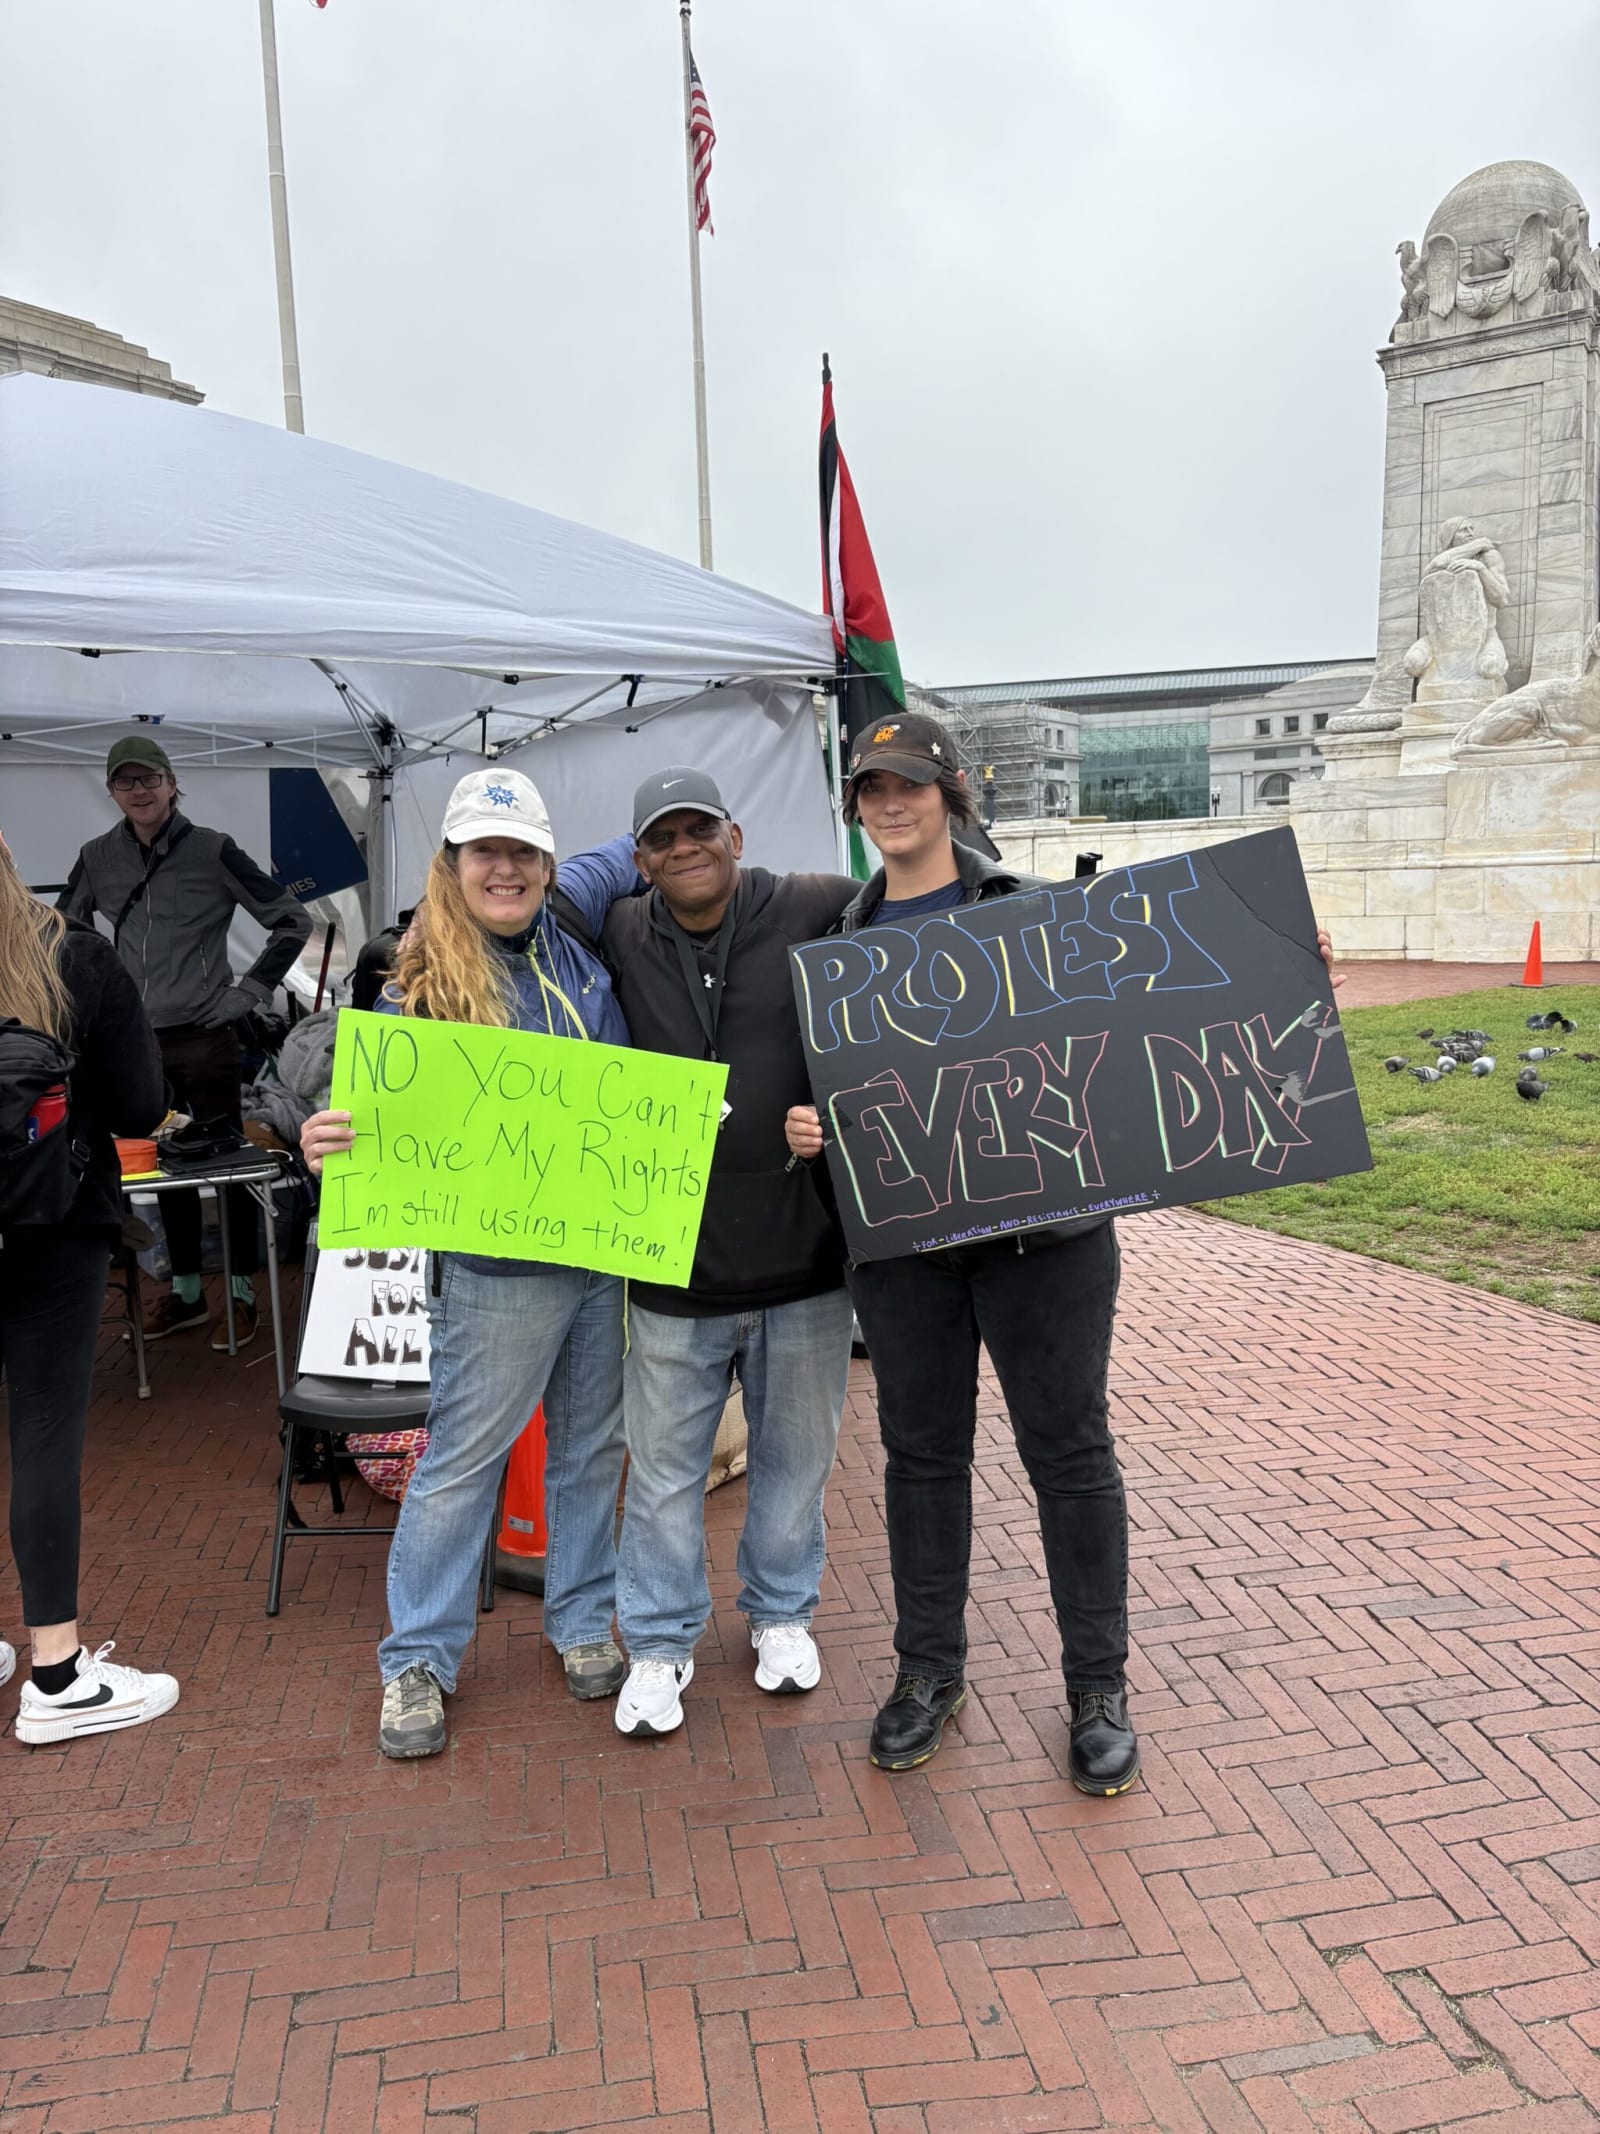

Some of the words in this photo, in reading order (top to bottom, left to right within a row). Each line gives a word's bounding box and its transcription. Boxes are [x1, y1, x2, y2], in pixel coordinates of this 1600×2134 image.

[793, 854, 1231, 1054] PROTEST
[351, 1027, 419, 1094] NO
[598, 1060, 714, 1141] Can't
[828, 1030, 1111, 1227] EVERY
[1144, 1000, 1333, 1176] DAY
[347, 1107, 474, 1171] Have
[485, 1121, 556, 1208] My
[577, 1120, 702, 1217] Rights
[331, 1171, 389, 1234] I'm
[401, 1189, 459, 1226] still
[480, 1205, 567, 1249] using
[583, 1219, 689, 1267] them!
[343, 1318, 423, 1367] ALL
[371, 1279, 428, 1317] FOR
